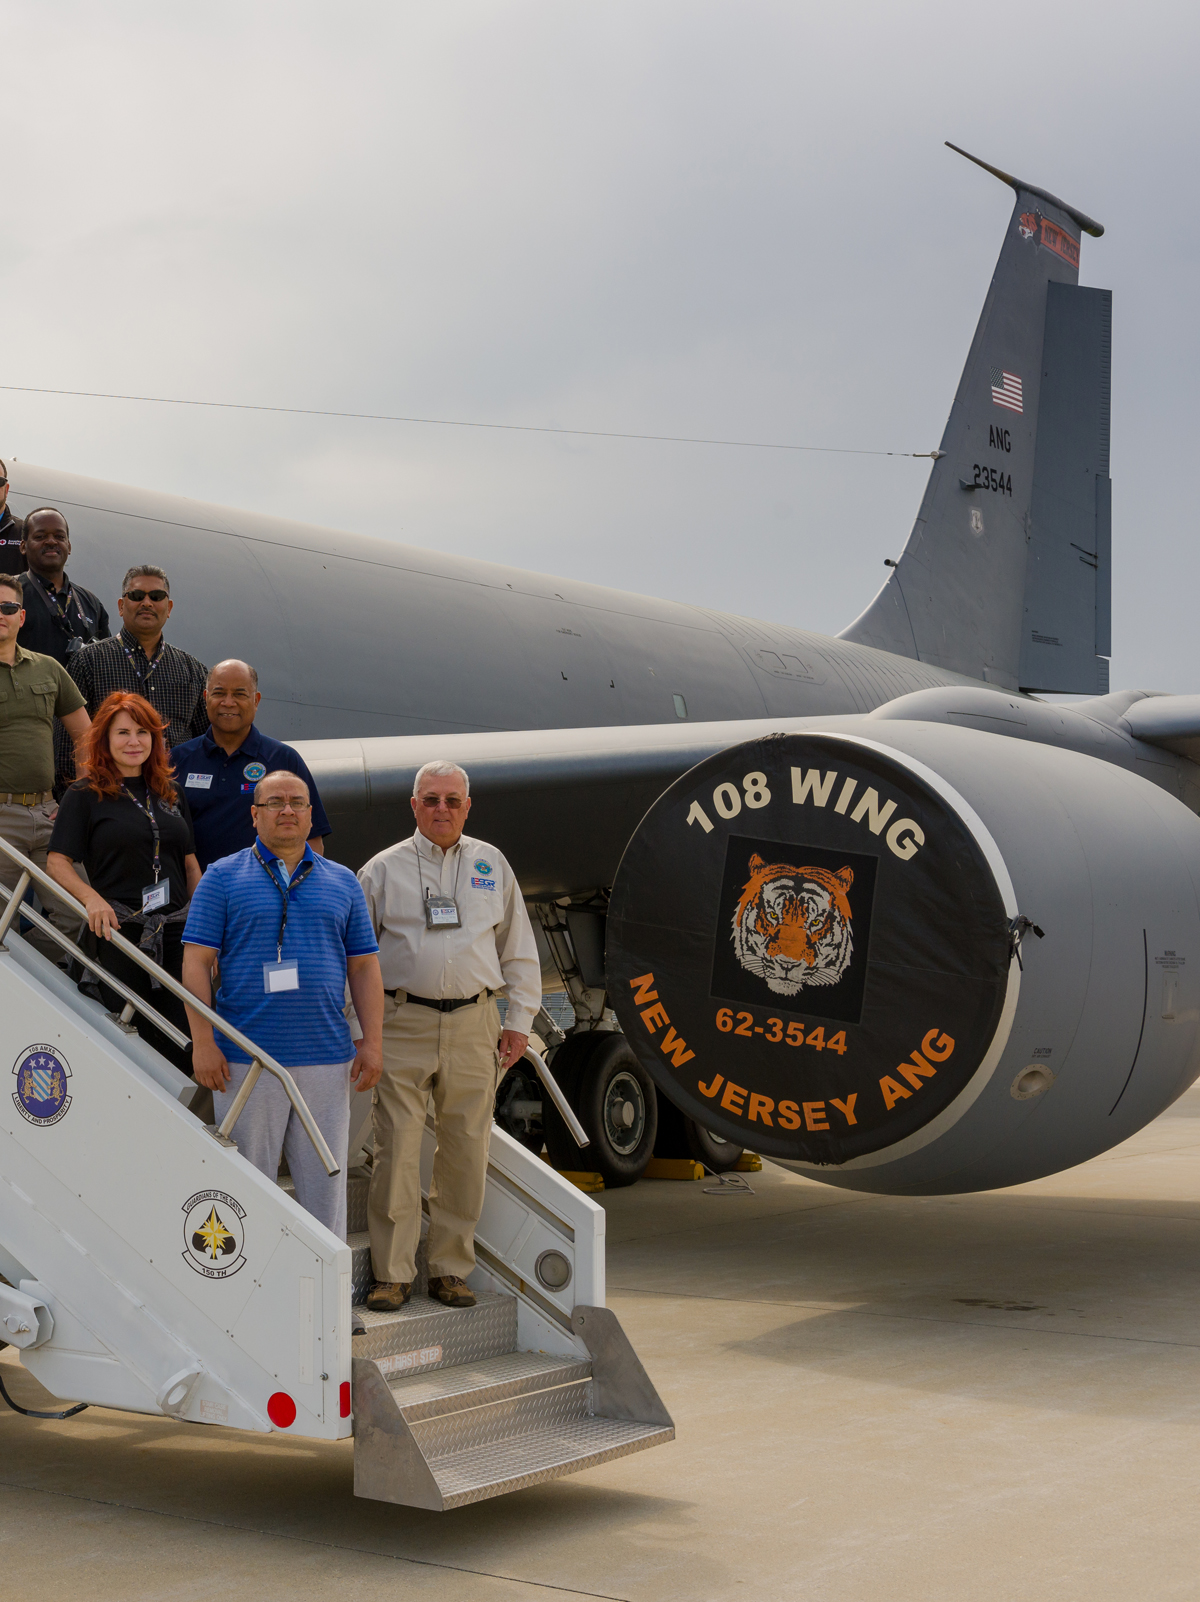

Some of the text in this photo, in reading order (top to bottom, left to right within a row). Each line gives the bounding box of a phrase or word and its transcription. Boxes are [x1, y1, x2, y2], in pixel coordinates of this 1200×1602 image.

[989, 424, 1011, 453] ANG
[973, 463, 1012, 497] 23544
[686, 766, 925, 860] 108 WING
[471, 877, 496, 888] ESGR
[630, 972, 695, 1068] NEW
[715, 1007, 848, 1055] 62-3544
[698, 1028, 956, 1132] JERSEY ANG
[14, 1096, 69, 1124] LIBERTY AND PROSPERITY
[186, 1191, 212, 1211] GUARDIANS
[219, 1193, 228, 1203] THE
[202, 1268, 227, 1277] 150 TH
[395, 1353, 417, 1369] FIRST
[420, 1348, 439, 1363] STEP
